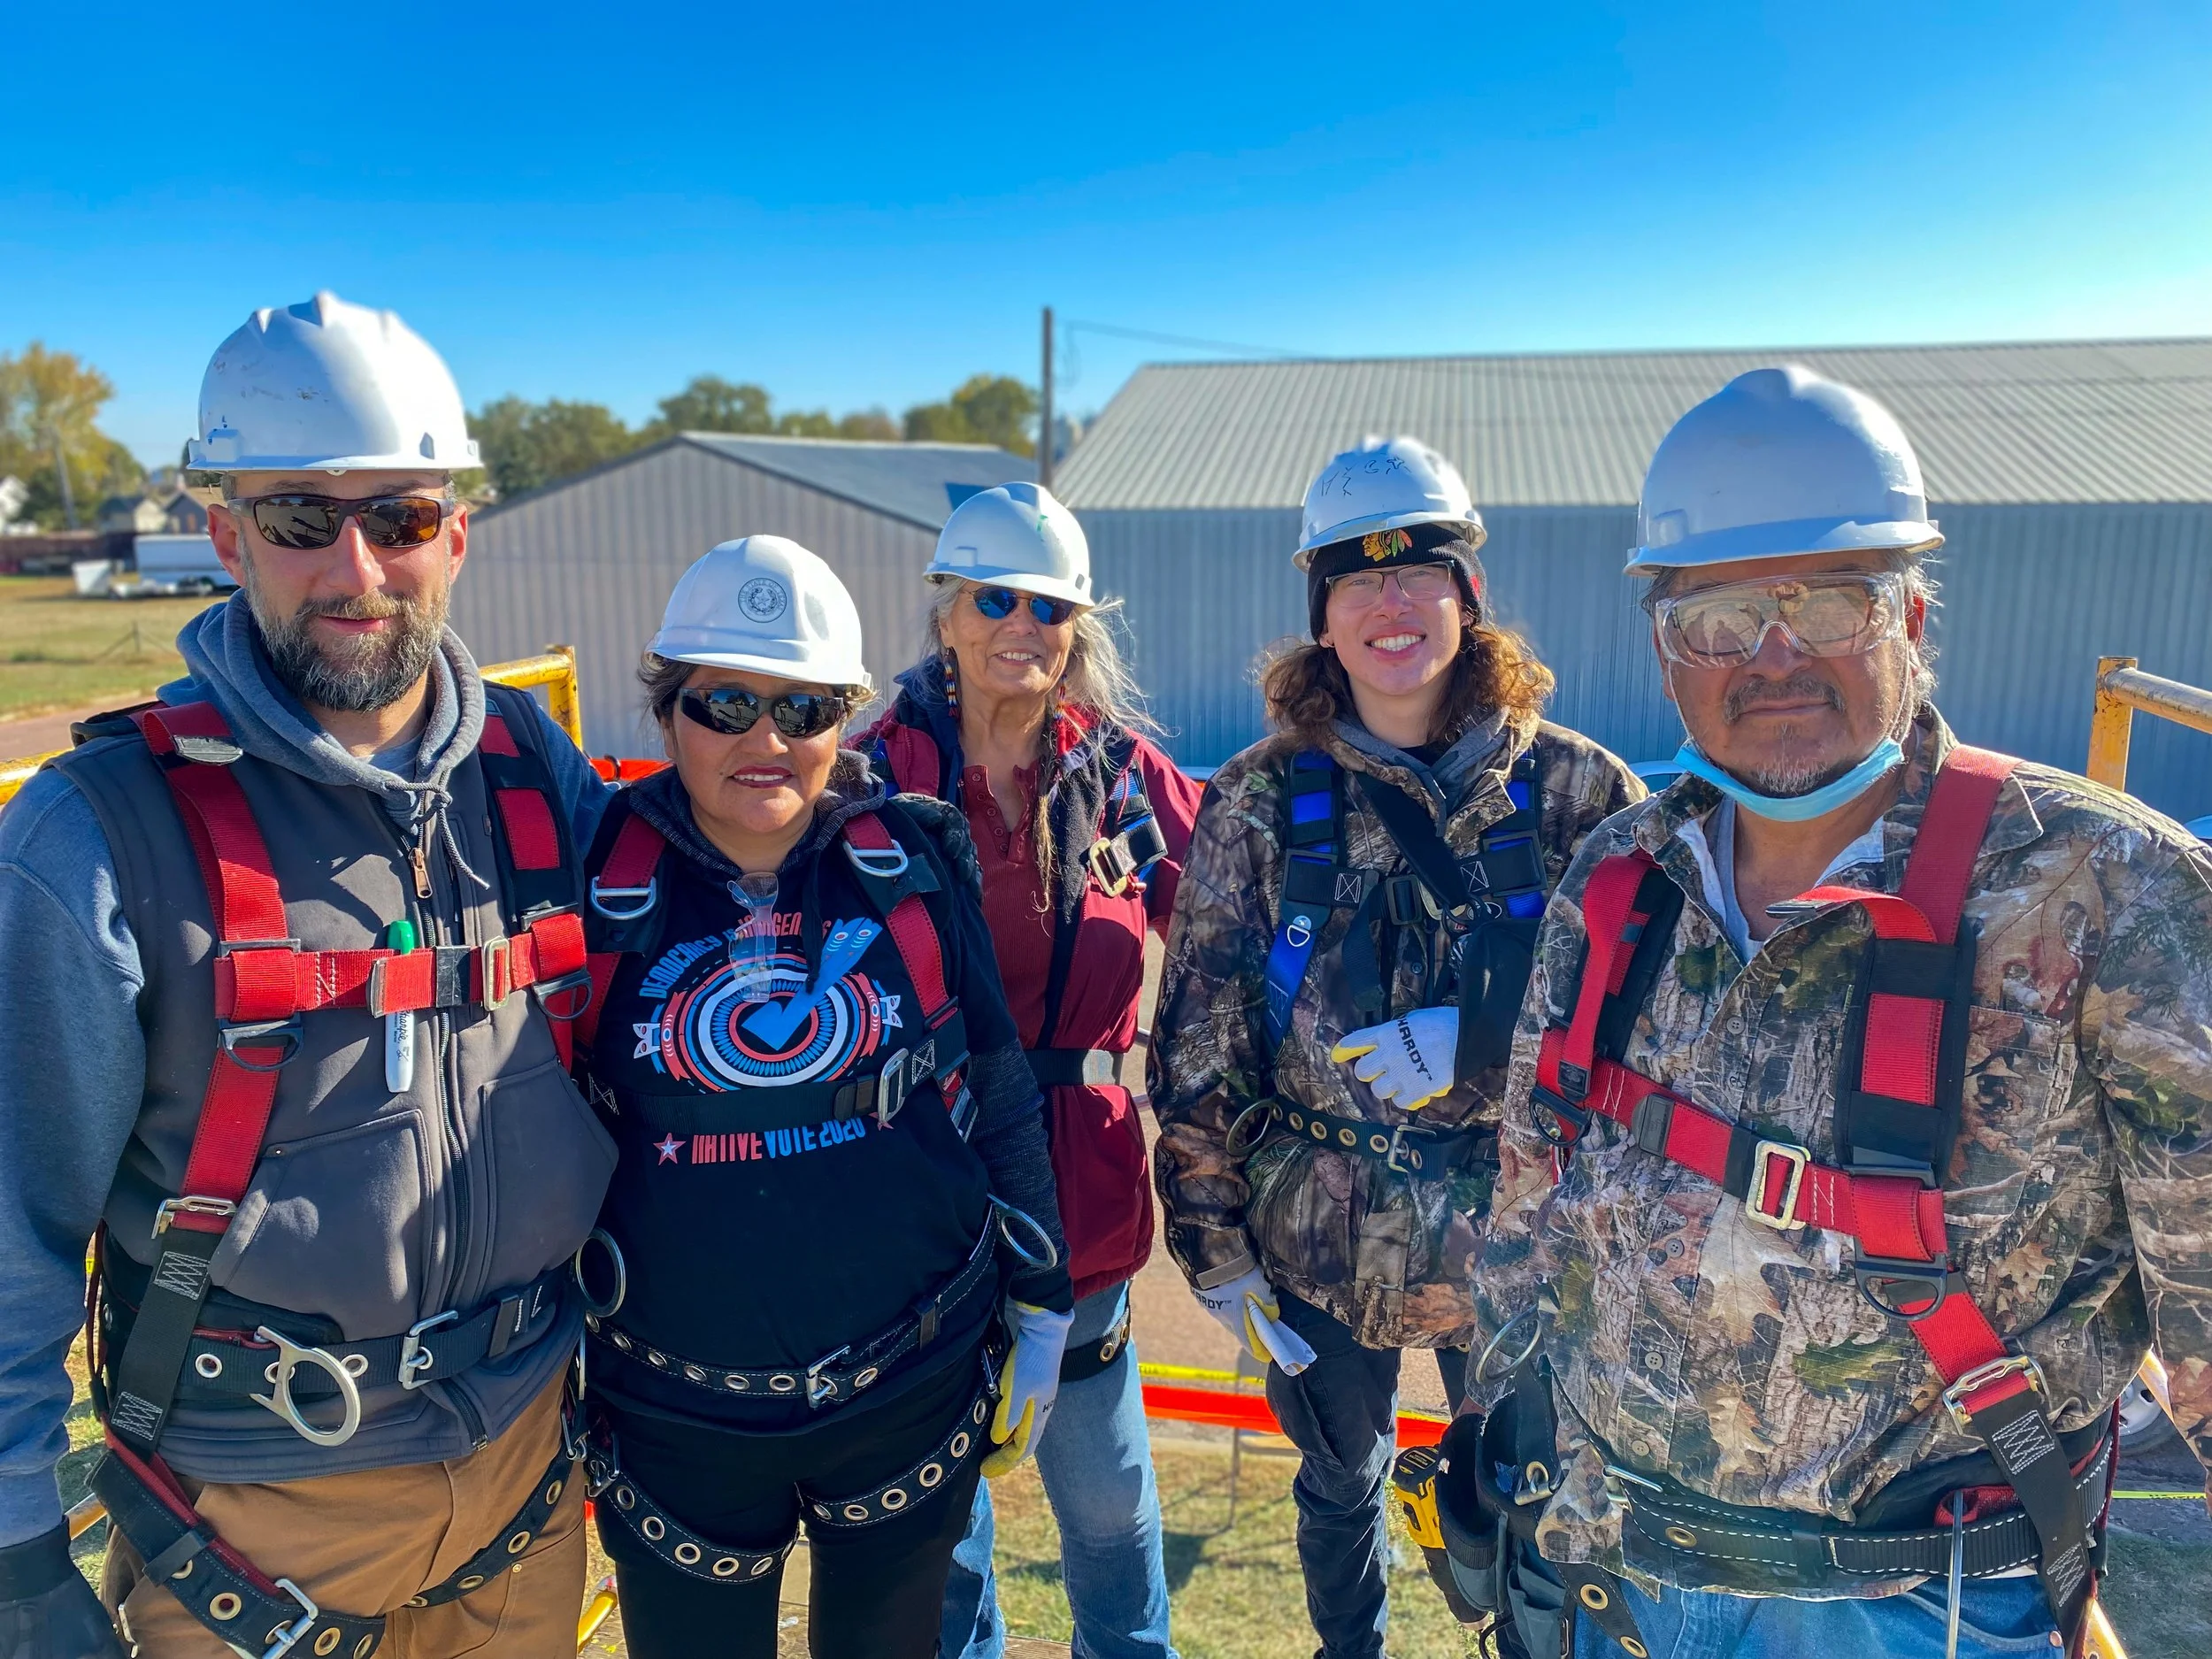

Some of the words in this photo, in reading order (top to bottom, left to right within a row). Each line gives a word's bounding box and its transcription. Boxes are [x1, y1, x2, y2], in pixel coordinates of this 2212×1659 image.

[639, 935, 723, 999] DEMOCRACY
[737, 911, 833, 940] INDIGENS
[764, 1125, 818, 1159] VOTE
[818, 1118, 866, 1148] 2020
